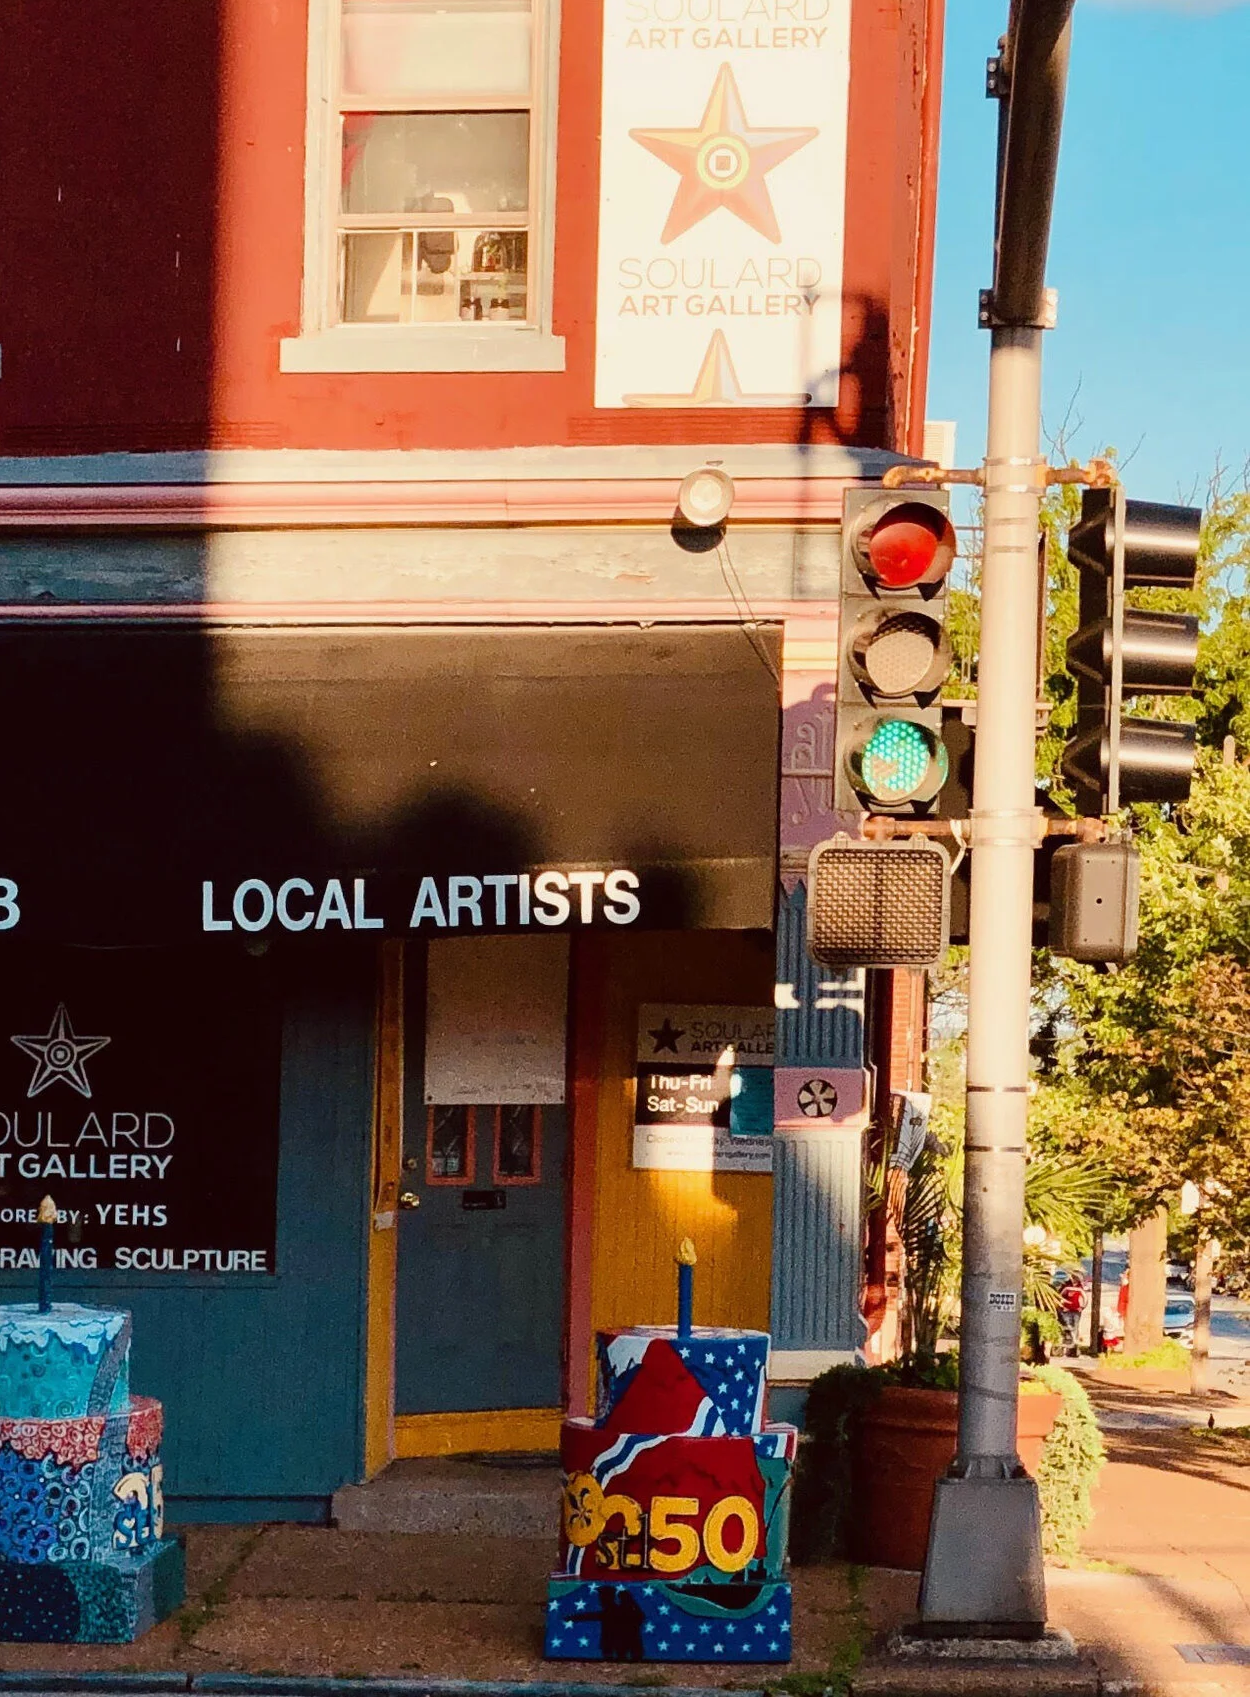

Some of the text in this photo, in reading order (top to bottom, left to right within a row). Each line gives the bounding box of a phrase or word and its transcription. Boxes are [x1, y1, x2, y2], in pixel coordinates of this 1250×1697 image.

[626, 27, 829, 49] ART GALLERY
[619, 257, 822, 289] SOULARD
[619, 294, 822, 316] ART GALLERY
[203, 878, 383, 931] LOCAL
[410, 871, 640, 927] ARTISTS
[647, 1095, 719, 1114] Sat-Sun
[18, 1153, 173, 1179] GALLERY
[96, 1204, 168, 1227] YEHS
[115, 1247, 267, 1271] SCULPTURE
